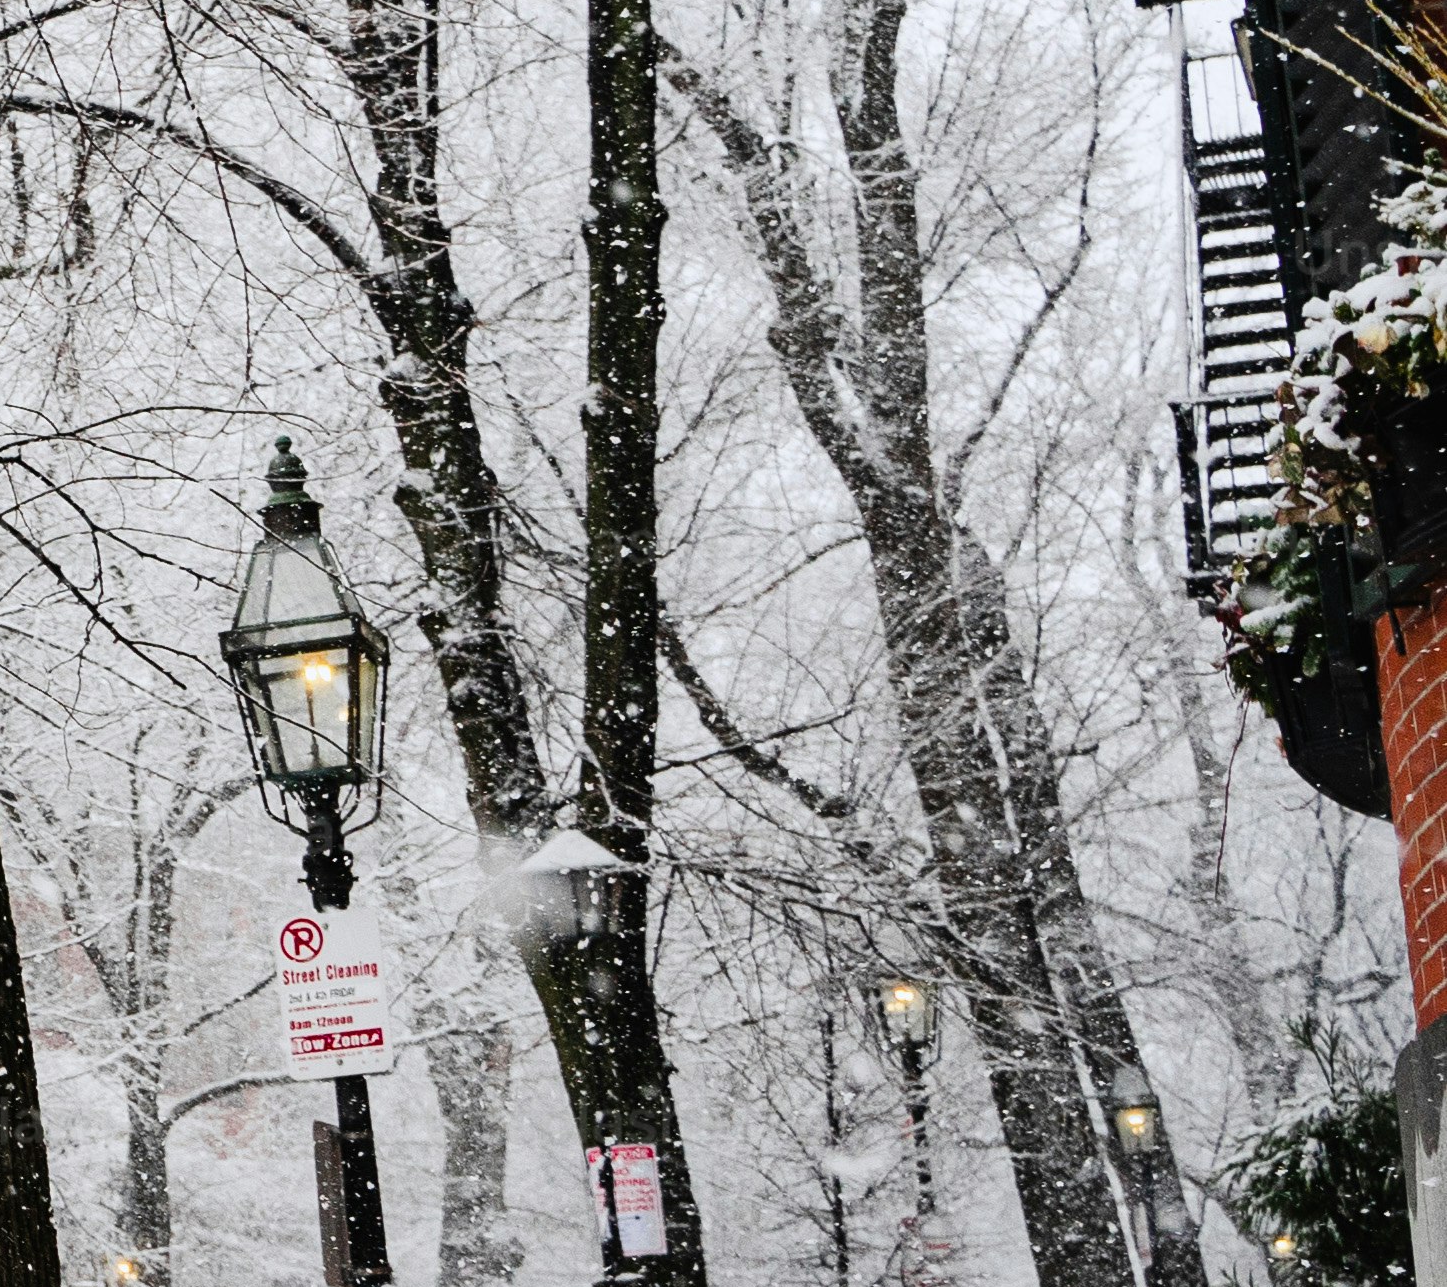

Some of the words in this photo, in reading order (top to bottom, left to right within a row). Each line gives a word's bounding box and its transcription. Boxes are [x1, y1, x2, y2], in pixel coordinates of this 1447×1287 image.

[282, 967, 320, 985] Street
[326, 962, 378, 980] Cleaning
[292, 1037, 325, 1053] Tow
[332, 1034, 369, 1049] Zone
